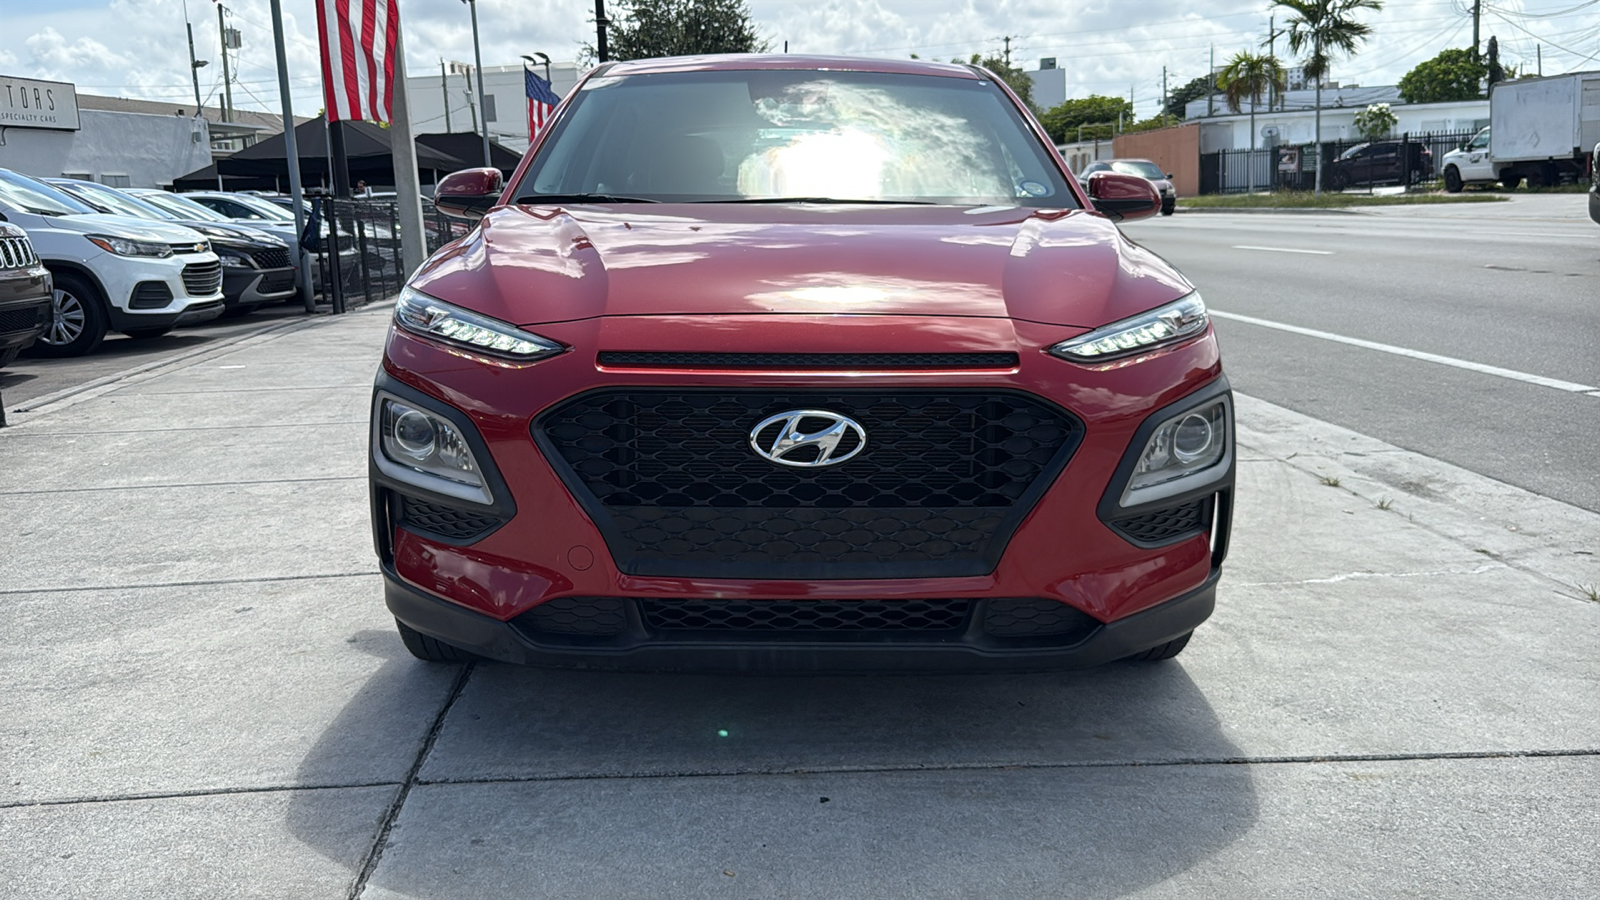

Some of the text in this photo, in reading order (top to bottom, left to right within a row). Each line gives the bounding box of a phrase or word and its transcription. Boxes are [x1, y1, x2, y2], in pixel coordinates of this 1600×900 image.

[5, 85, 55, 111] TORS
[1, 112, 56, 123] SPECIALTY CARS
